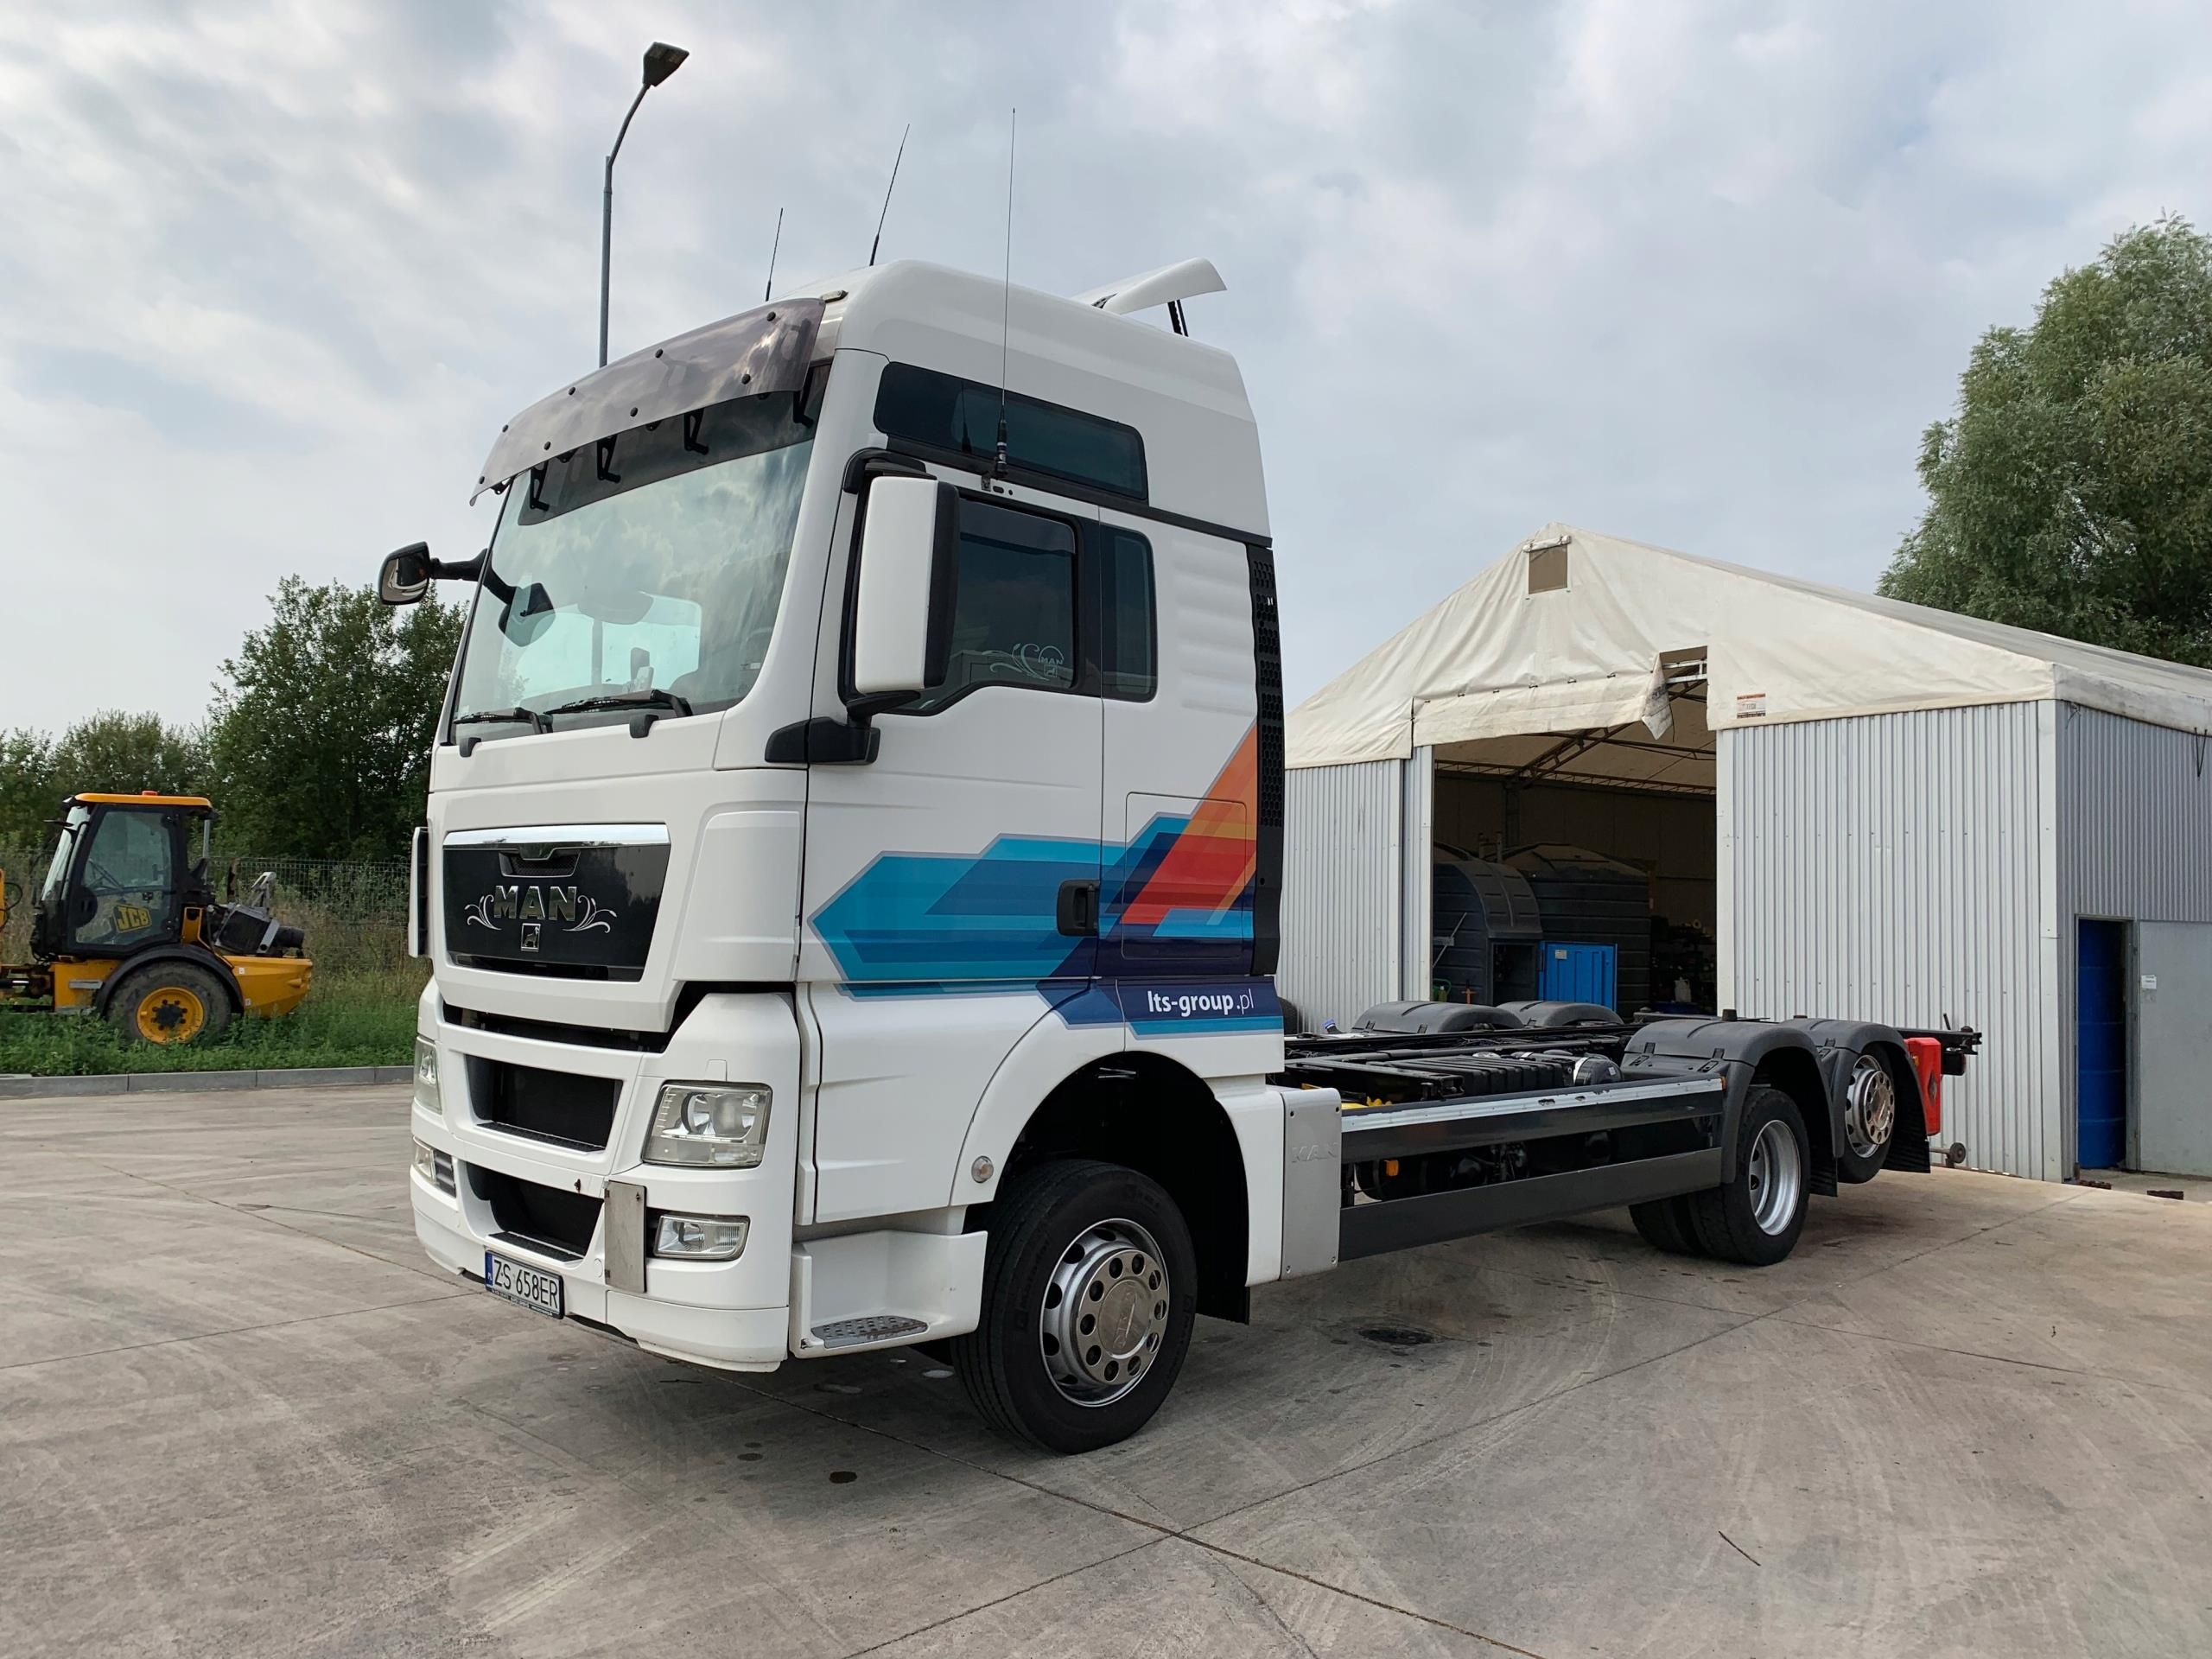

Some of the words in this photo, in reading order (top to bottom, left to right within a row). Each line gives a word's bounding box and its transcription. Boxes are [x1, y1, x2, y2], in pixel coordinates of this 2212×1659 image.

[1040, 656, 1064, 665] MAN
[118, 906, 149, 930] JCB
[493, 885, 577, 922] MAN
[493, 1259, 512, 1290] ZS
[516, 1268, 558, 1309] 658ER
